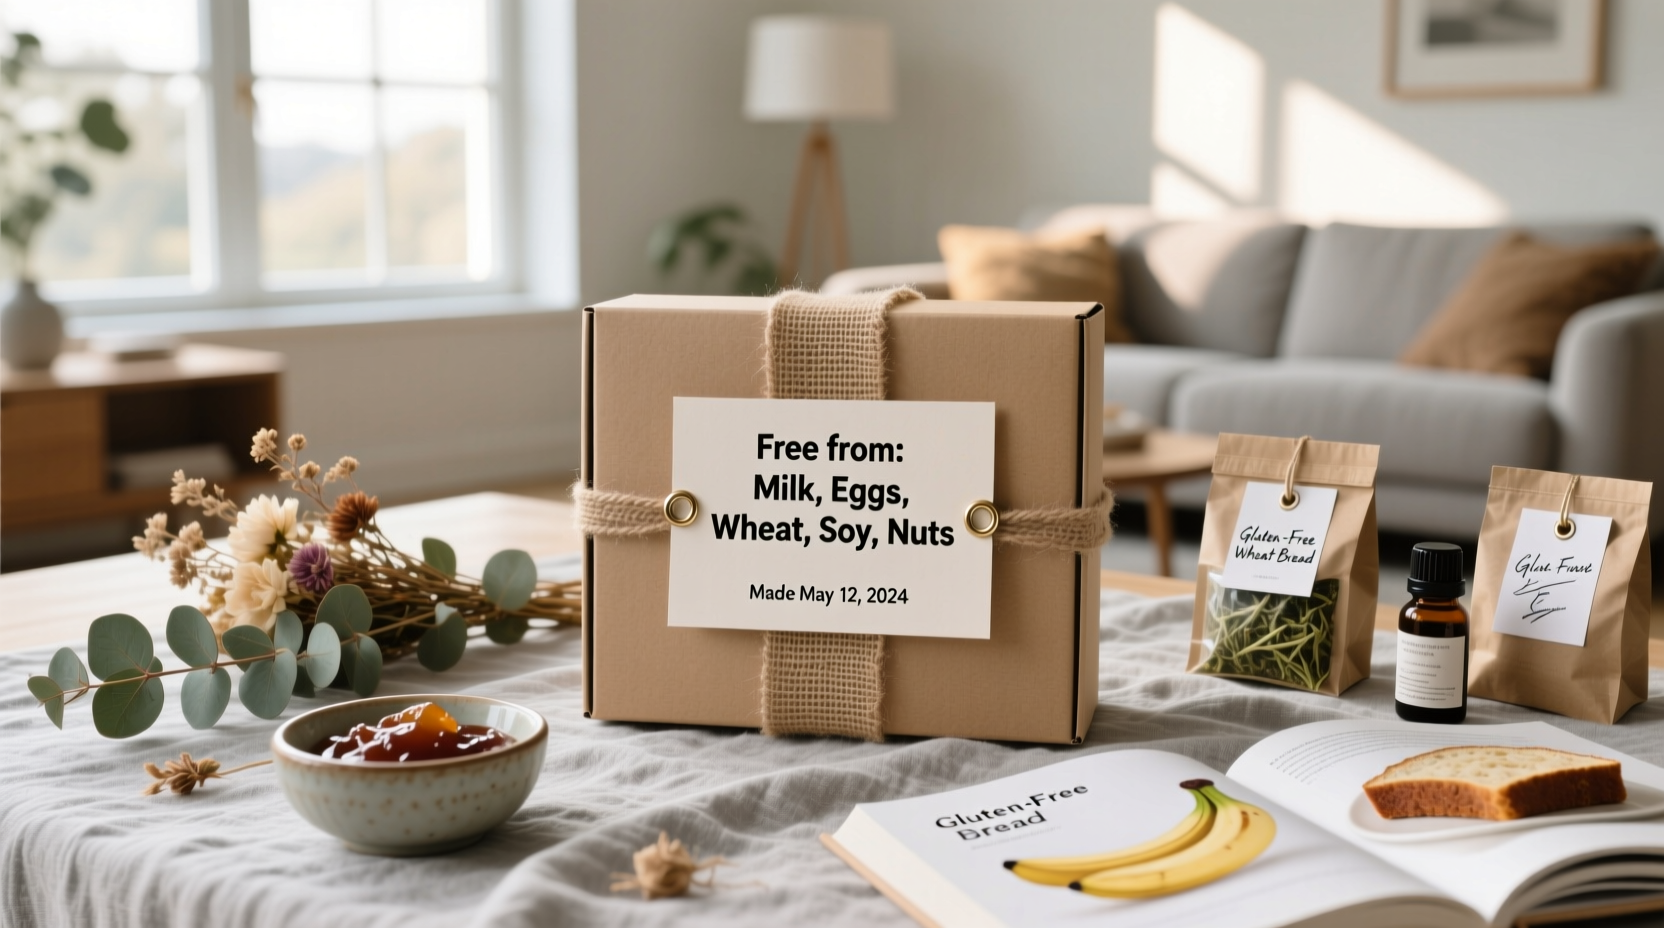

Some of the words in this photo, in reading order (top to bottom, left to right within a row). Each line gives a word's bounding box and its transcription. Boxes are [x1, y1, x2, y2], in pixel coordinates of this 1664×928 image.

[757, 433, 819, 460] Free
[827, 433, 904, 462] from:
[754, 474, 822, 507] Milk,
[831, 476, 909, 511] Eggs,
[711, 513, 811, 548] Wheat,
[819, 516, 879, 551] Soy,
[888, 518, 955, 546] Nuts
[1235, 544, 1276, 560] Wheat
[1276, 547, 1317, 564] Bread
[749, 584, 796, 602] Made
[800, 585, 834, 606] May
[840, 587, 862, 606] 12,
[867, 587, 909, 604] 2024
[935, 784, 1088, 828] Gluten-Free
[956, 810, 1047, 841] Bread
